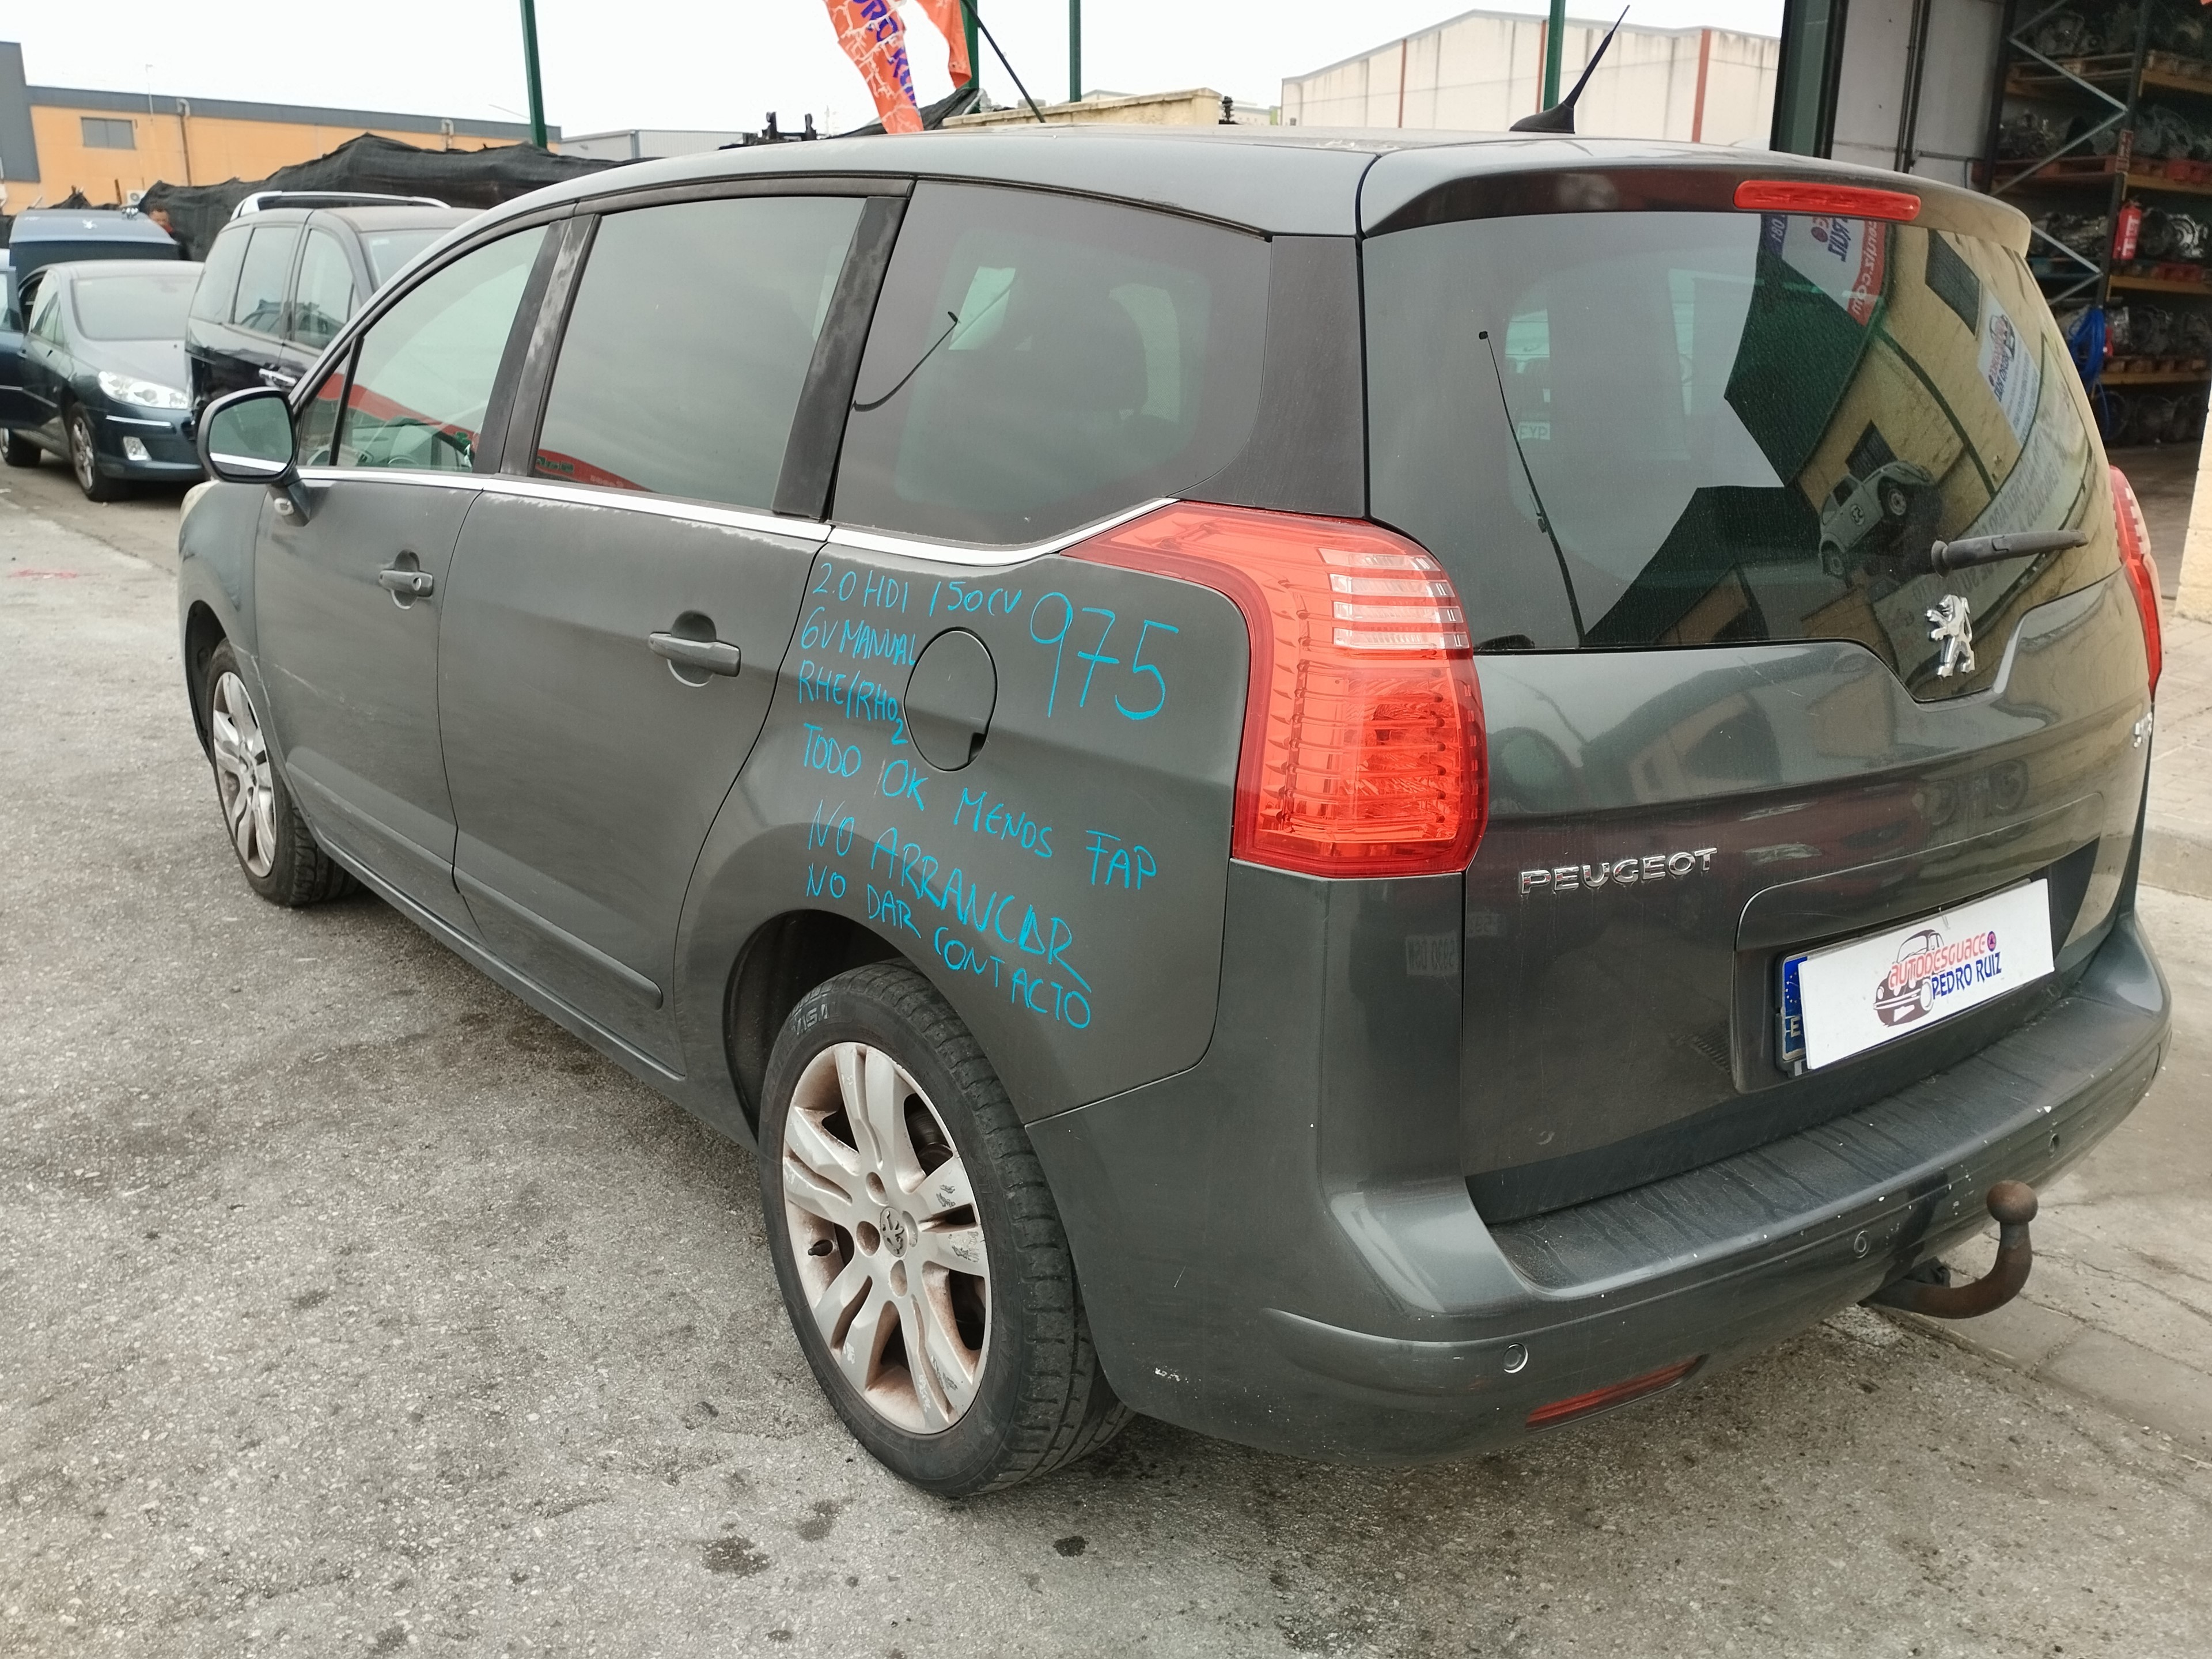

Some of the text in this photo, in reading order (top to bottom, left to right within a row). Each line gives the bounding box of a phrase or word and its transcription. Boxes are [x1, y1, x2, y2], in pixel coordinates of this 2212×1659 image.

[813, 562, 857, 602] 2.0
[865, 575, 908, 613] HDI
[839, 619, 916, 666] MANUAL
[1029, 592, 1179, 721] 975
[804, 723, 1157, 890] TODO OK MENOS FAP
[808, 799, 1092, 993] NO ARRANCAR
[1519, 847, 1718, 894] PEUGEOT
[806, 863, 1090, 1029] NO DAR CONTACTO
[1931, 952, 2002, 999] PEDRO RUIZ
